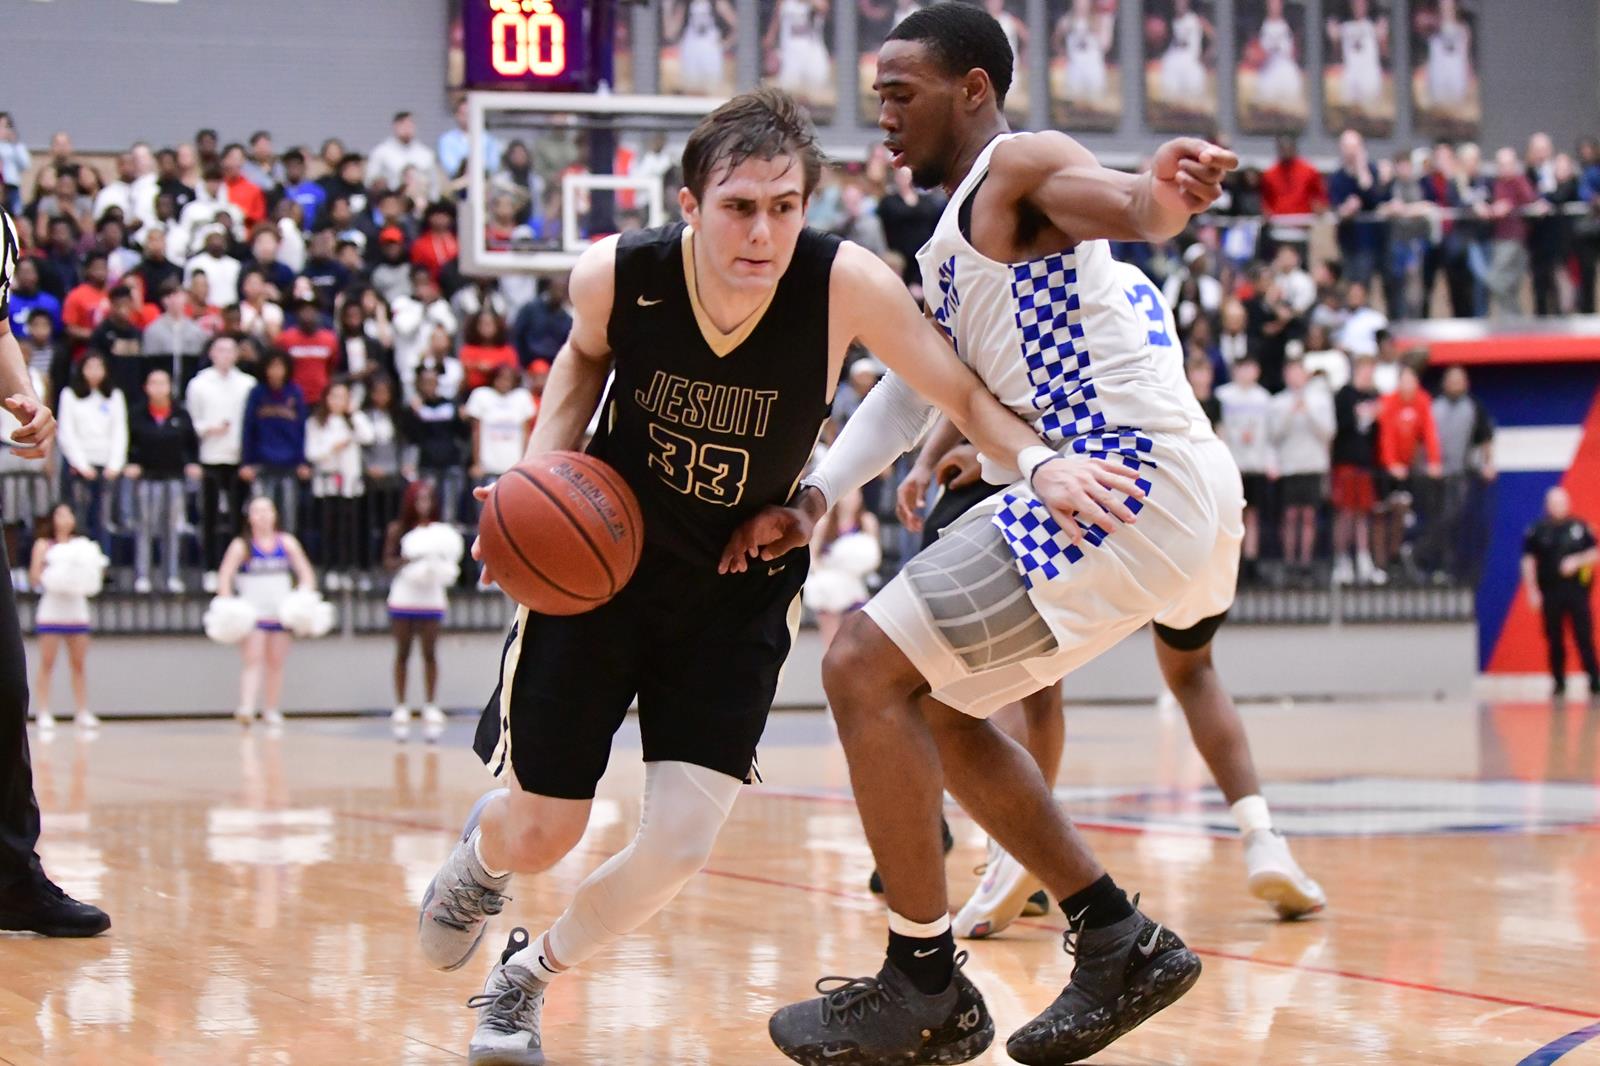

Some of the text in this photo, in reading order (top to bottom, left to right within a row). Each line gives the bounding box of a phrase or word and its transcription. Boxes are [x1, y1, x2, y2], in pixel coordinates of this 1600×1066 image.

[491, 11, 566, 77] 00
[634, 370, 779, 438] JESUIT
[647, 422, 750, 508] 33
